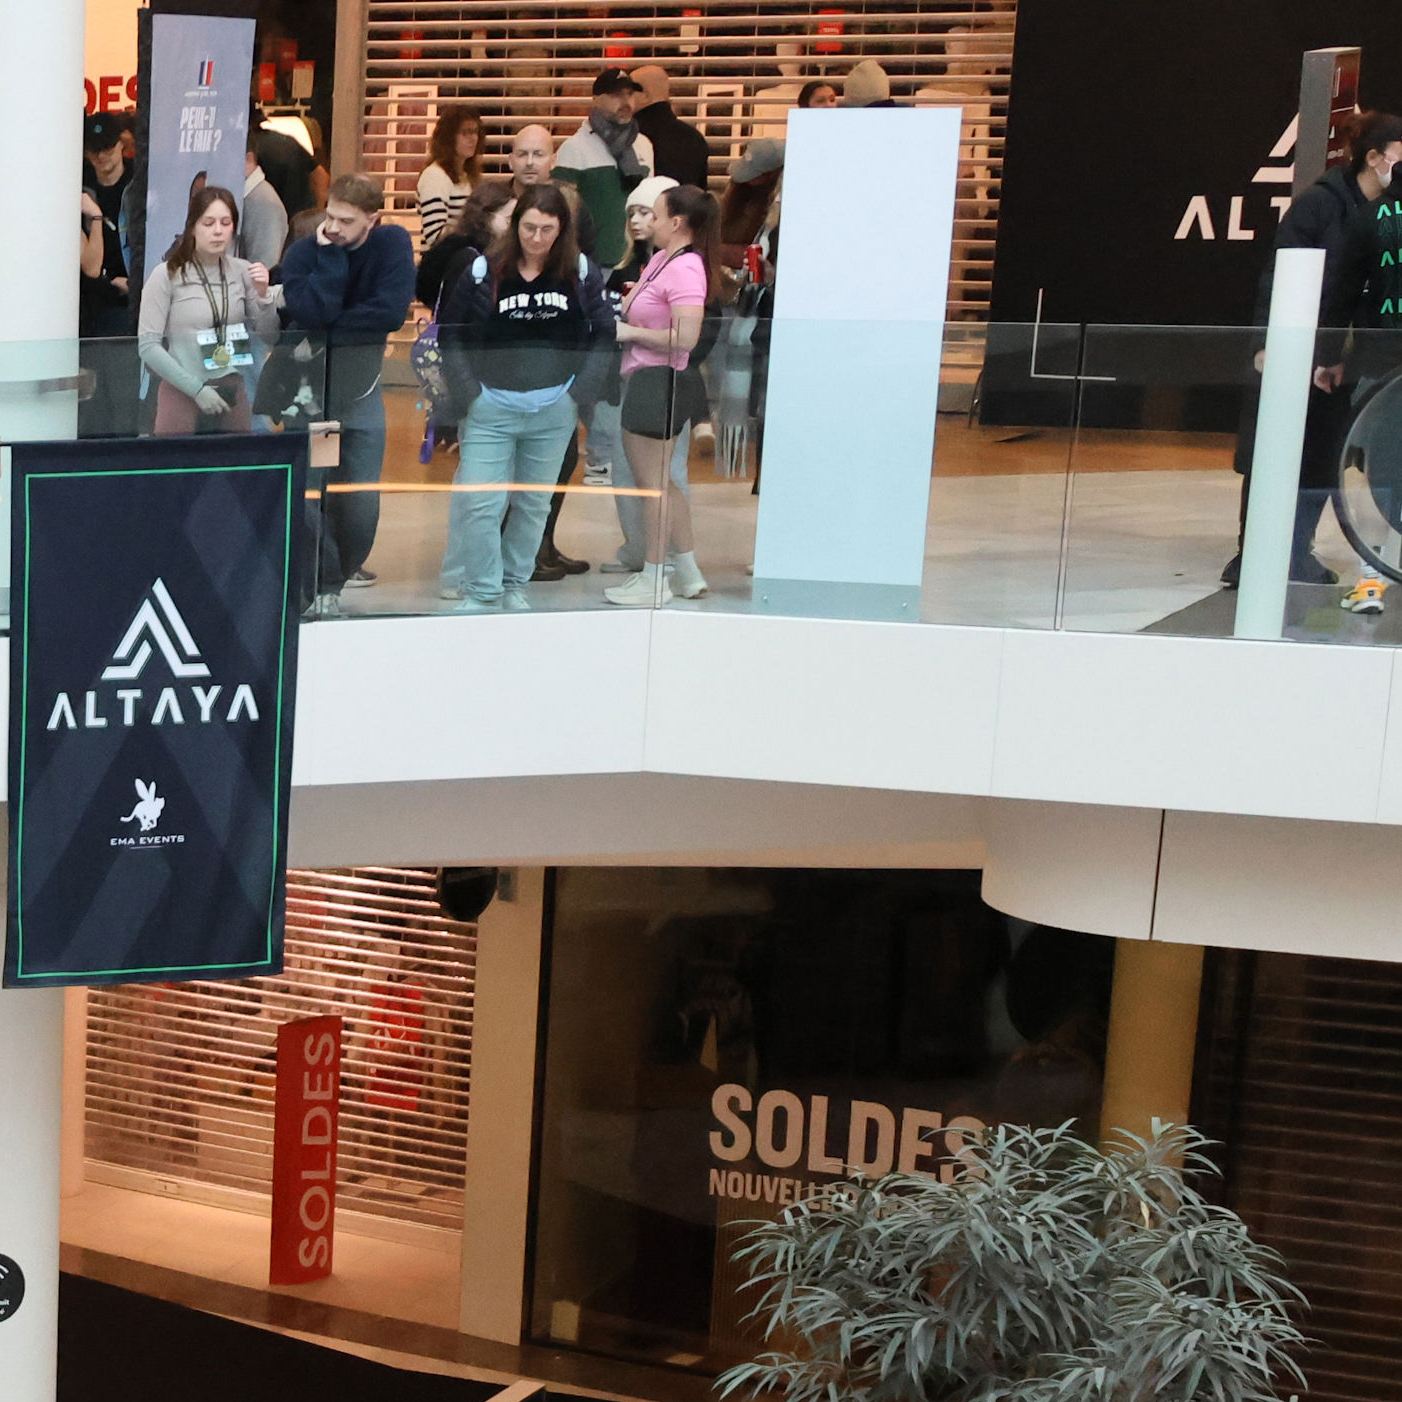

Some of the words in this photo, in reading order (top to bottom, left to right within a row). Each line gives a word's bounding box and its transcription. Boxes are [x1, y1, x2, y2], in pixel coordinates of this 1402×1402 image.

[499, 293, 530, 313] NEW
[534, 291, 568, 311] YORK
[46, 683, 260, 731] ALTAYA
[110, 838, 135, 846] EMA
[139, 835, 185, 845] EVENTS
[298, 1031, 335, 1269] SOLDES
[709, 1083, 989, 1186] SOLDES
